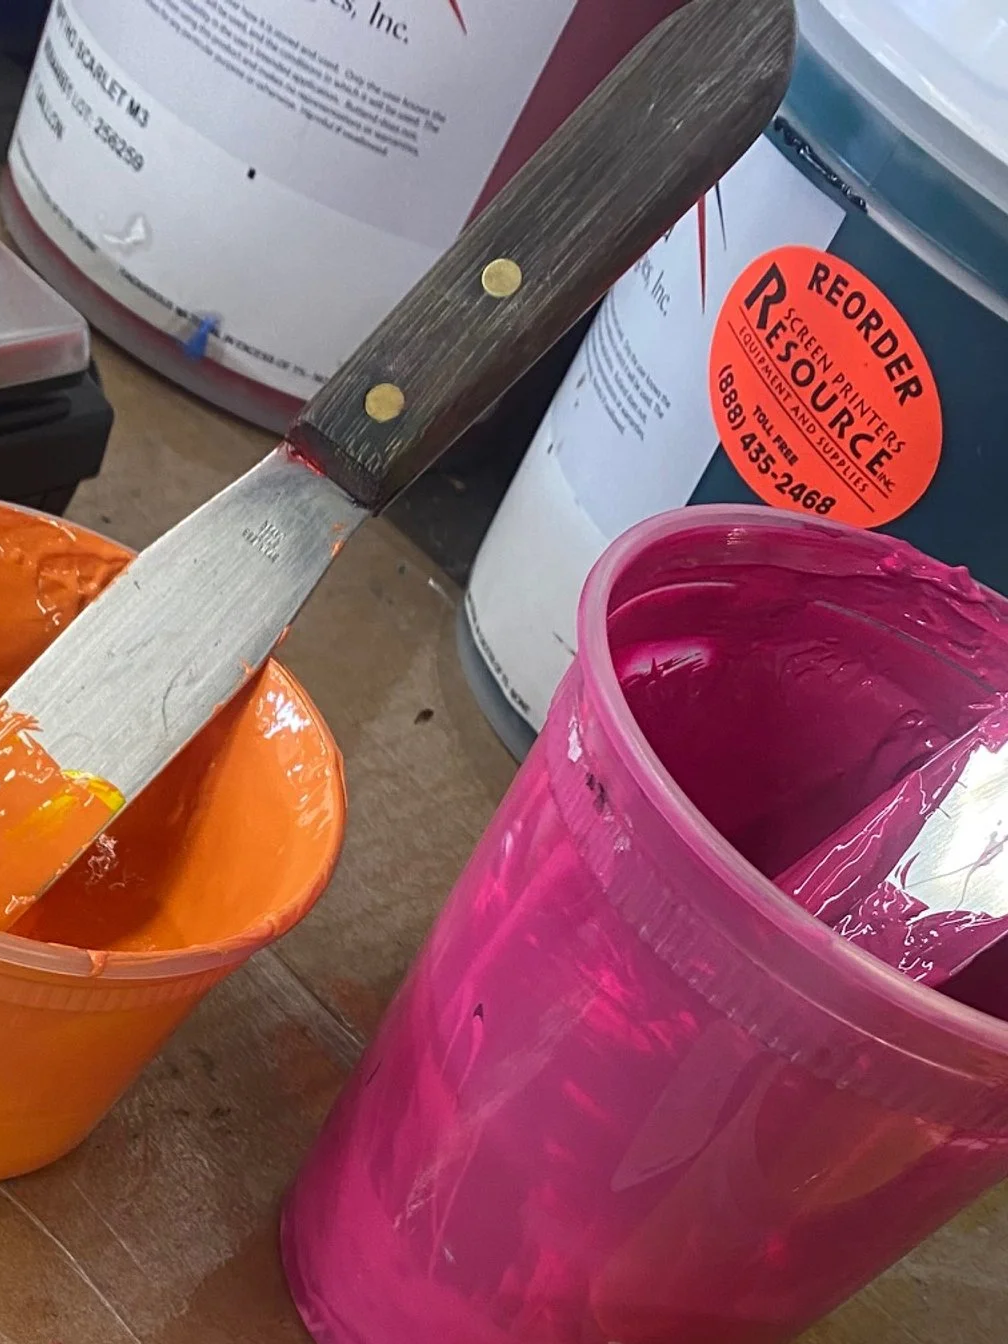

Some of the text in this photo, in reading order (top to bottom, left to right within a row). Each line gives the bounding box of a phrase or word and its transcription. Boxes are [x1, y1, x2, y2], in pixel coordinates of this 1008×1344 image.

[75, 38, 150, 129] SCARLET M3
[369, 1, 409, 45] Inc.
[93, 116, 145, 172] 256259
[742, 260, 894, 478] RESOURCE
[782, 306, 907, 462] SCREEN PRINTERS
[807, 261, 924, 407] REORDER
[717, 362, 837, 516] (888) 435-2468
[737, 324, 870, 494] EQUIPMENT AND SUPPLIES
[751, 403, 800, 467] TOLL FREE
